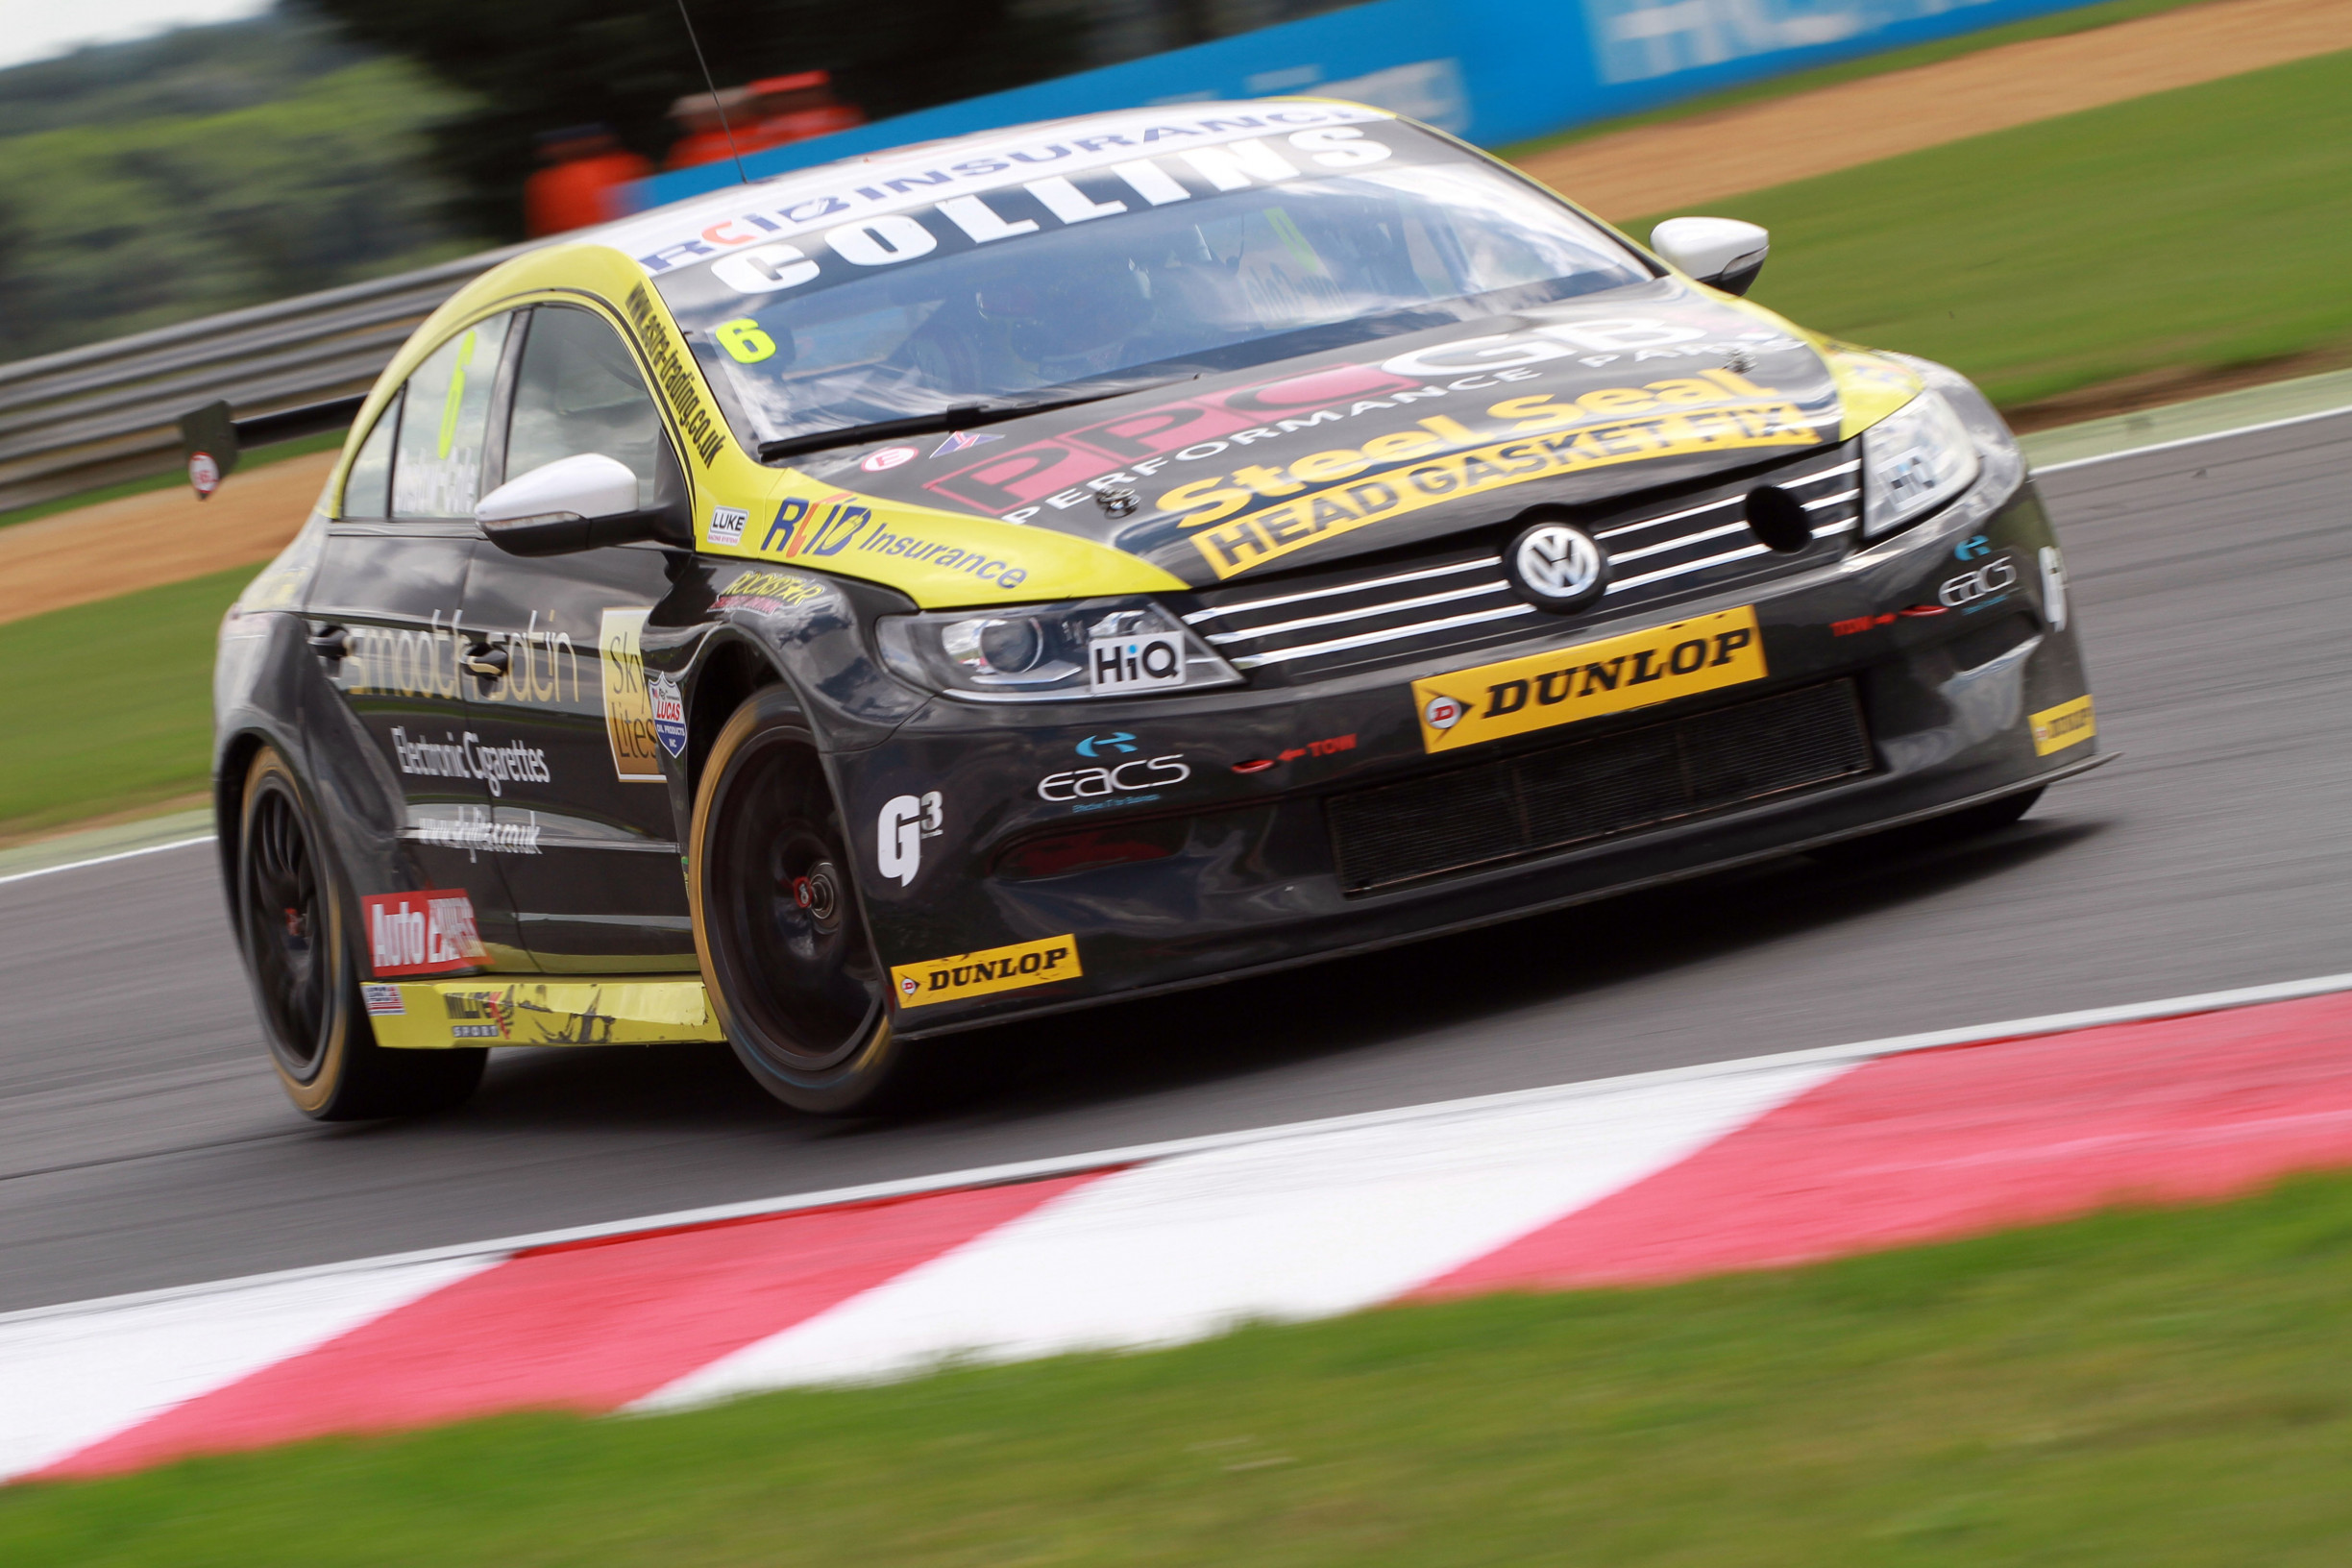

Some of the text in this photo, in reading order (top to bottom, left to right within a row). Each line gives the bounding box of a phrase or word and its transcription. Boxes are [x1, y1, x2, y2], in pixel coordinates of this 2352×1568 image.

[711, 126, 1392, 294] COLLINS
[715, 318, 777, 364] 6
[1001, 367, 1543, 525] PERFORMANCE
[1156, 414, 1495, 529] Steel
[1486, 367, 1780, 430] Seal
[1203, 406, 1802, 567] HEAD GASKET FIX
[712, 512, 746, 531] LUKE
[858, 523, 1028, 589] Insurance
[1095, 640, 1180, 685] HiQ
[1482, 627, 1752, 720] DUNLOP
[656, 701, 681, 722] LUCAS
[390, 725, 551, 797] Electronic Cigarettes
[1037, 752, 1191, 802] eacs
[1307, 733, 1358, 758] TOW
[371, 900, 427, 968] Auto
[927, 946, 1068, 992] DUNLOP
